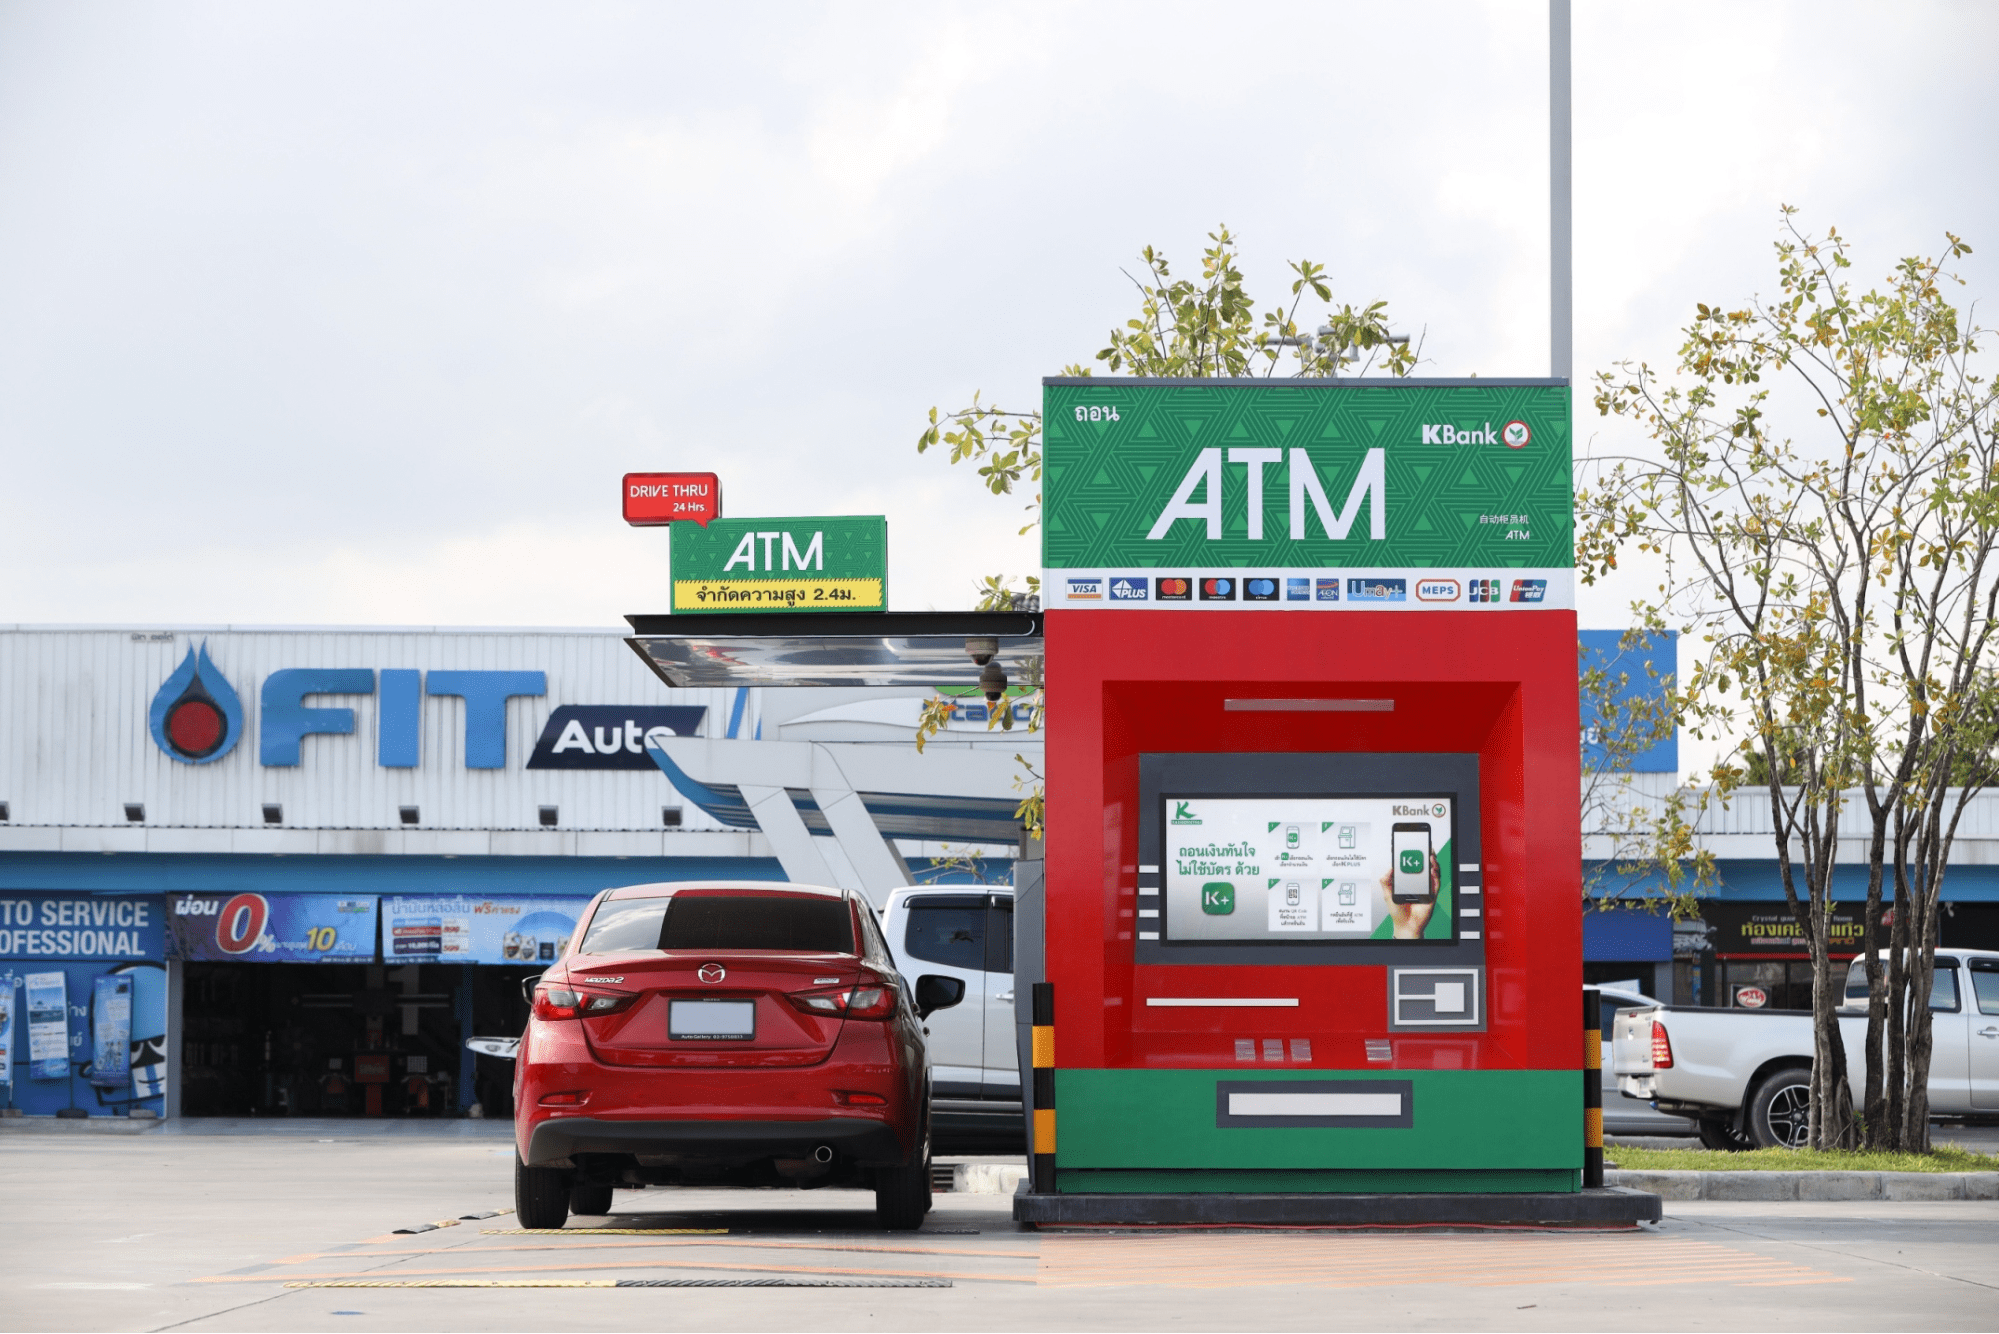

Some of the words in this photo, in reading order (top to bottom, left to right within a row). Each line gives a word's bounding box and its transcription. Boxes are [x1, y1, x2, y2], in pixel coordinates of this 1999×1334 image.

[1074, 405, 1121, 423] ถอน
[1421, 421, 1498, 446] KBank
[629, 483, 670, 498] DRIVE
[672, 483, 709, 498] THRU
[1144, 446, 1386, 541] ATM
[672, 501, 686, 513] 24
[687, 501, 708, 513] Hrs.
[1479, 513, 1530, 525] 自动柜员机
[1504, 530, 1530, 540] ATM
[722, 530, 824, 572] ATM
[695, 585, 806, 607] จำกัดความสูง
[1072, 584, 1098, 594] VISA
[1120, 588, 1147, 599] PLUS
[1422, 585, 1455, 596] MEPS
[1469, 586, 1499, 597] JCB
[1512, 584, 1545, 593] UnionPay
[260, 668, 547, 769] FIT
[1175, 800, 1198, 820] K
[1392, 803, 1430, 817] KBank
[1179, 841, 1257, 858] ถอนเงินทันใจ
[1175, 859, 1232, 876] ไม่ใช้บัตร
[1235, 860, 1260, 876] ด้วย
[1402, 856, 1421, 867] K+
[174, 893, 220, 916] ผ่อน
[1205, 890, 1230, 906] K+
[40, 900, 150, 927] SERVICE
[0, 929, 147, 956] OFESSIONAL
[305, 925, 338, 952] 10
